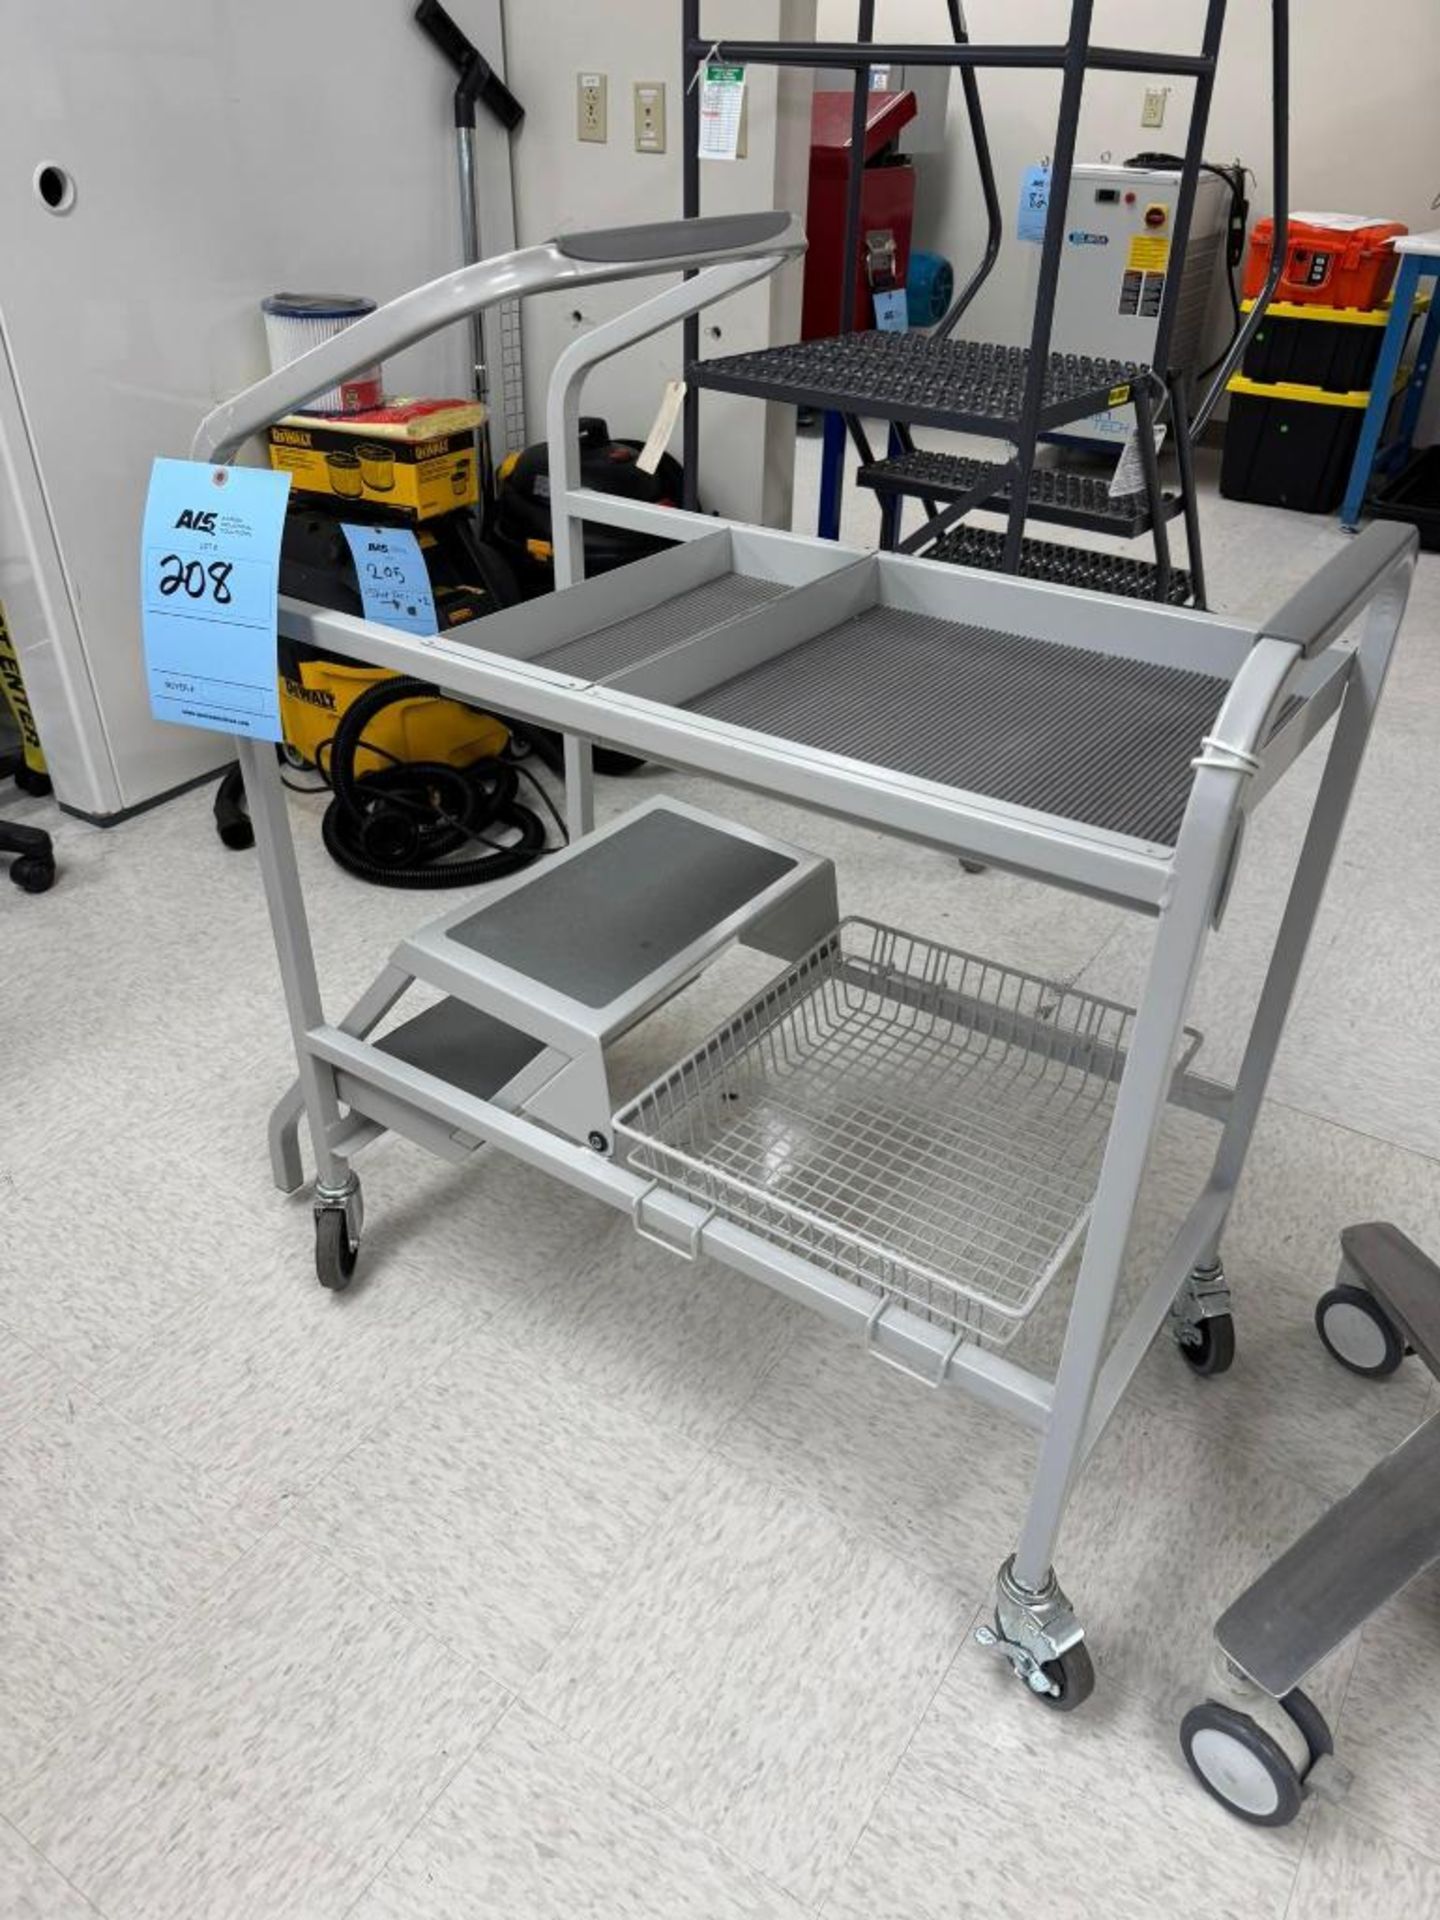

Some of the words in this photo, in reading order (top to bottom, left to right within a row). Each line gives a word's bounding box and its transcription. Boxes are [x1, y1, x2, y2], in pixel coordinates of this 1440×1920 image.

[159, 554, 234, 604] 208
[366, 563, 406, 584] 205
[0, 656, 41, 748] ENTER
